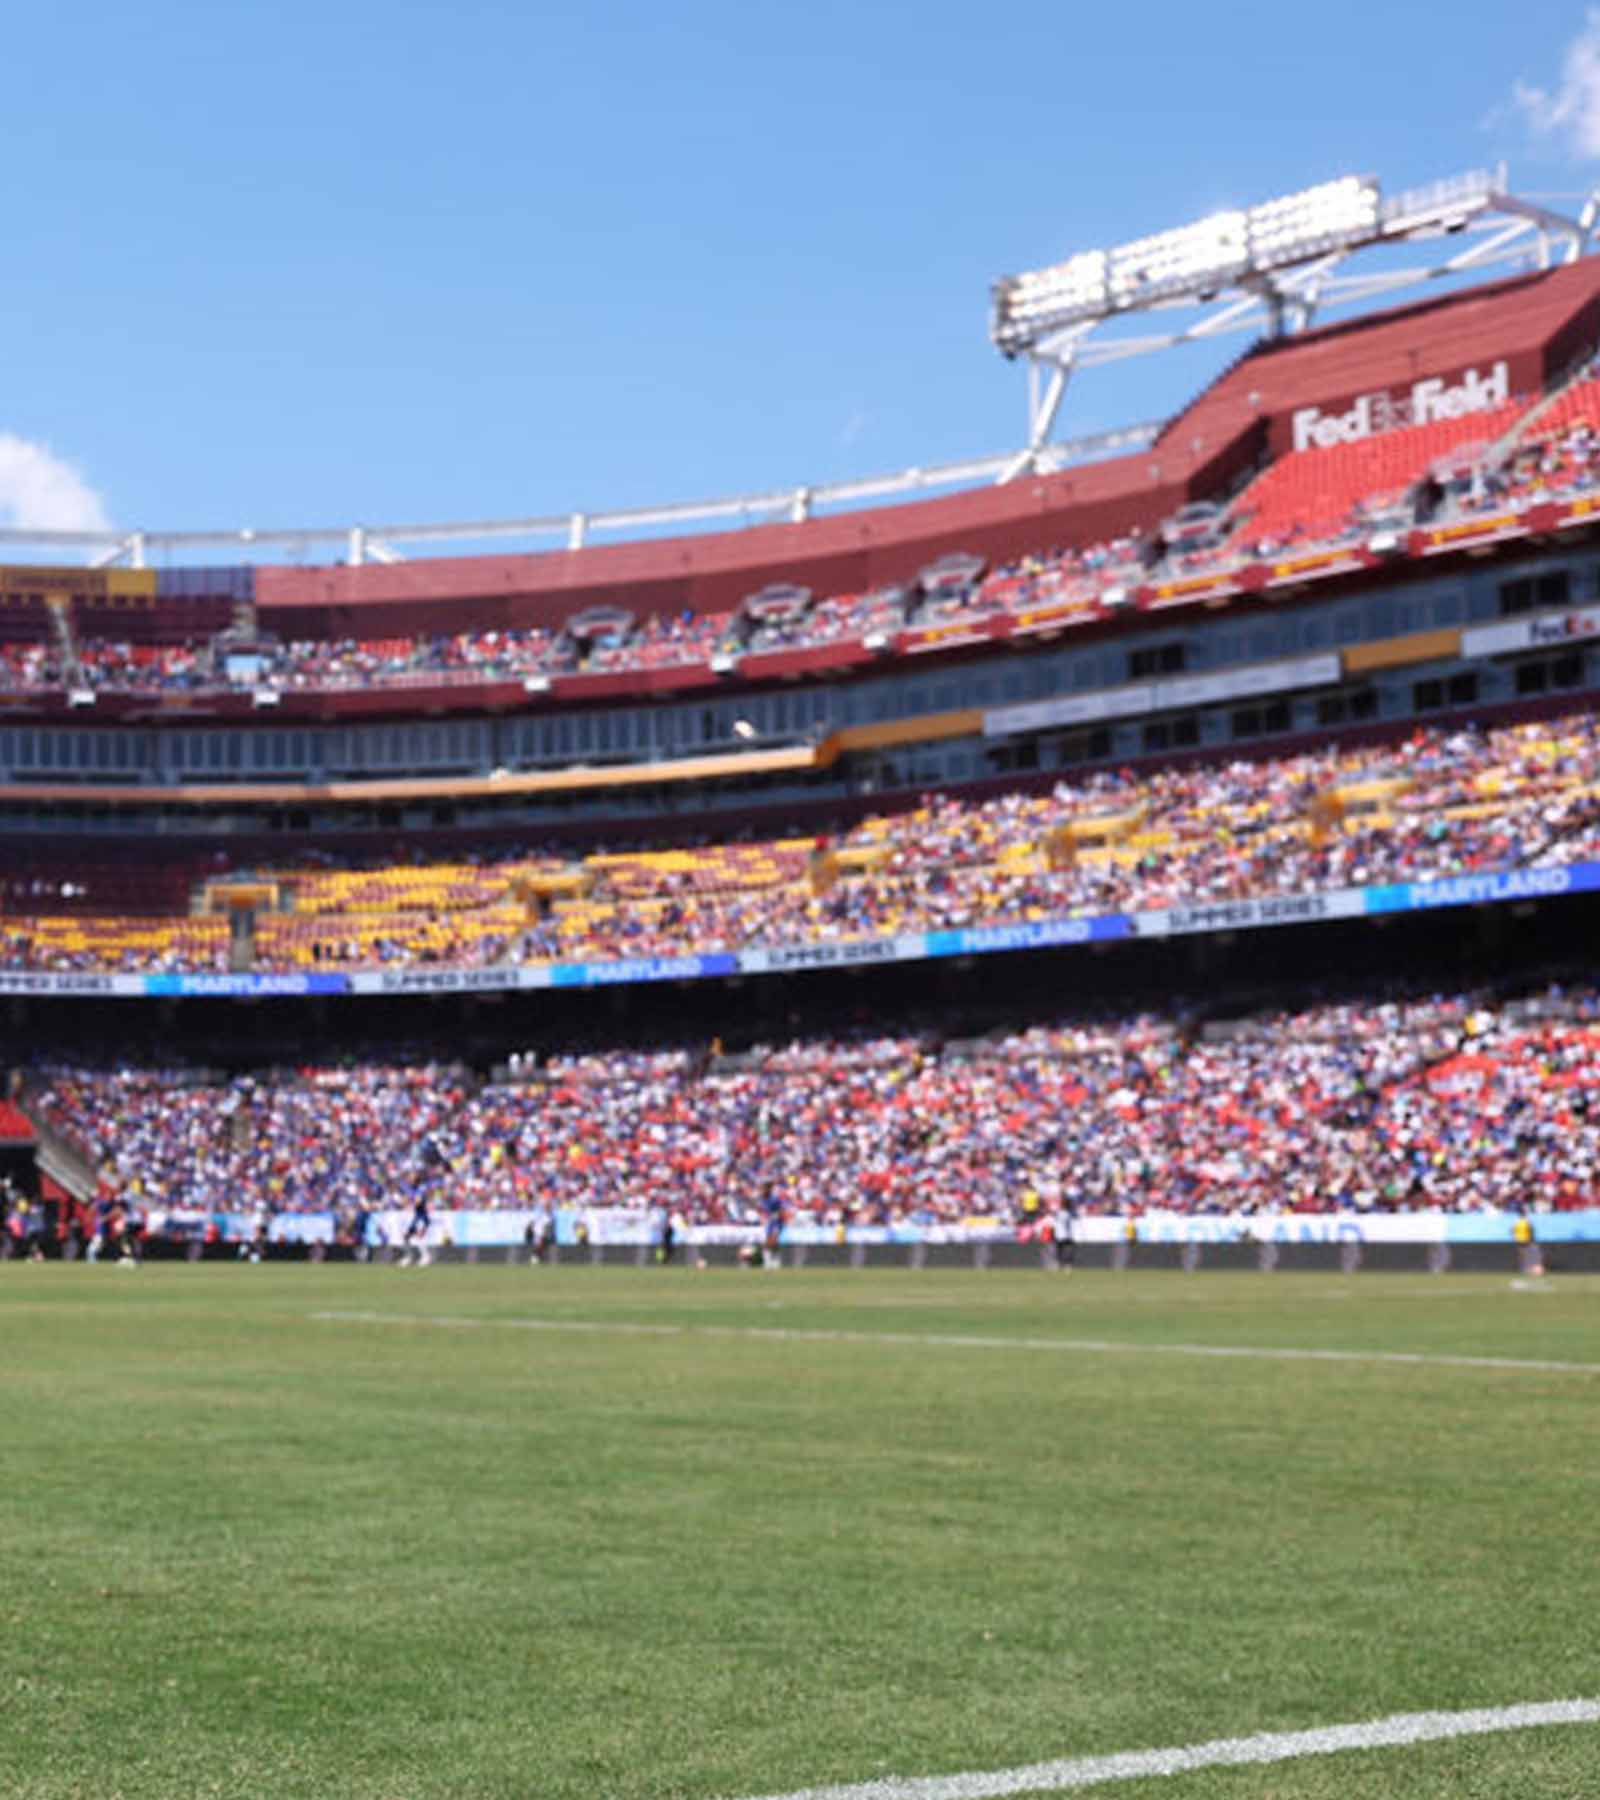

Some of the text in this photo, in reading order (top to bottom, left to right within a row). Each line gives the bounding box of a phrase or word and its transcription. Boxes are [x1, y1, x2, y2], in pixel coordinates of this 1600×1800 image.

[1409, 867, 1570, 906] MARYLAND
[963, 917, 1092, 949] MARYLAND
[182, 974, 308, 994] MARYLAND
